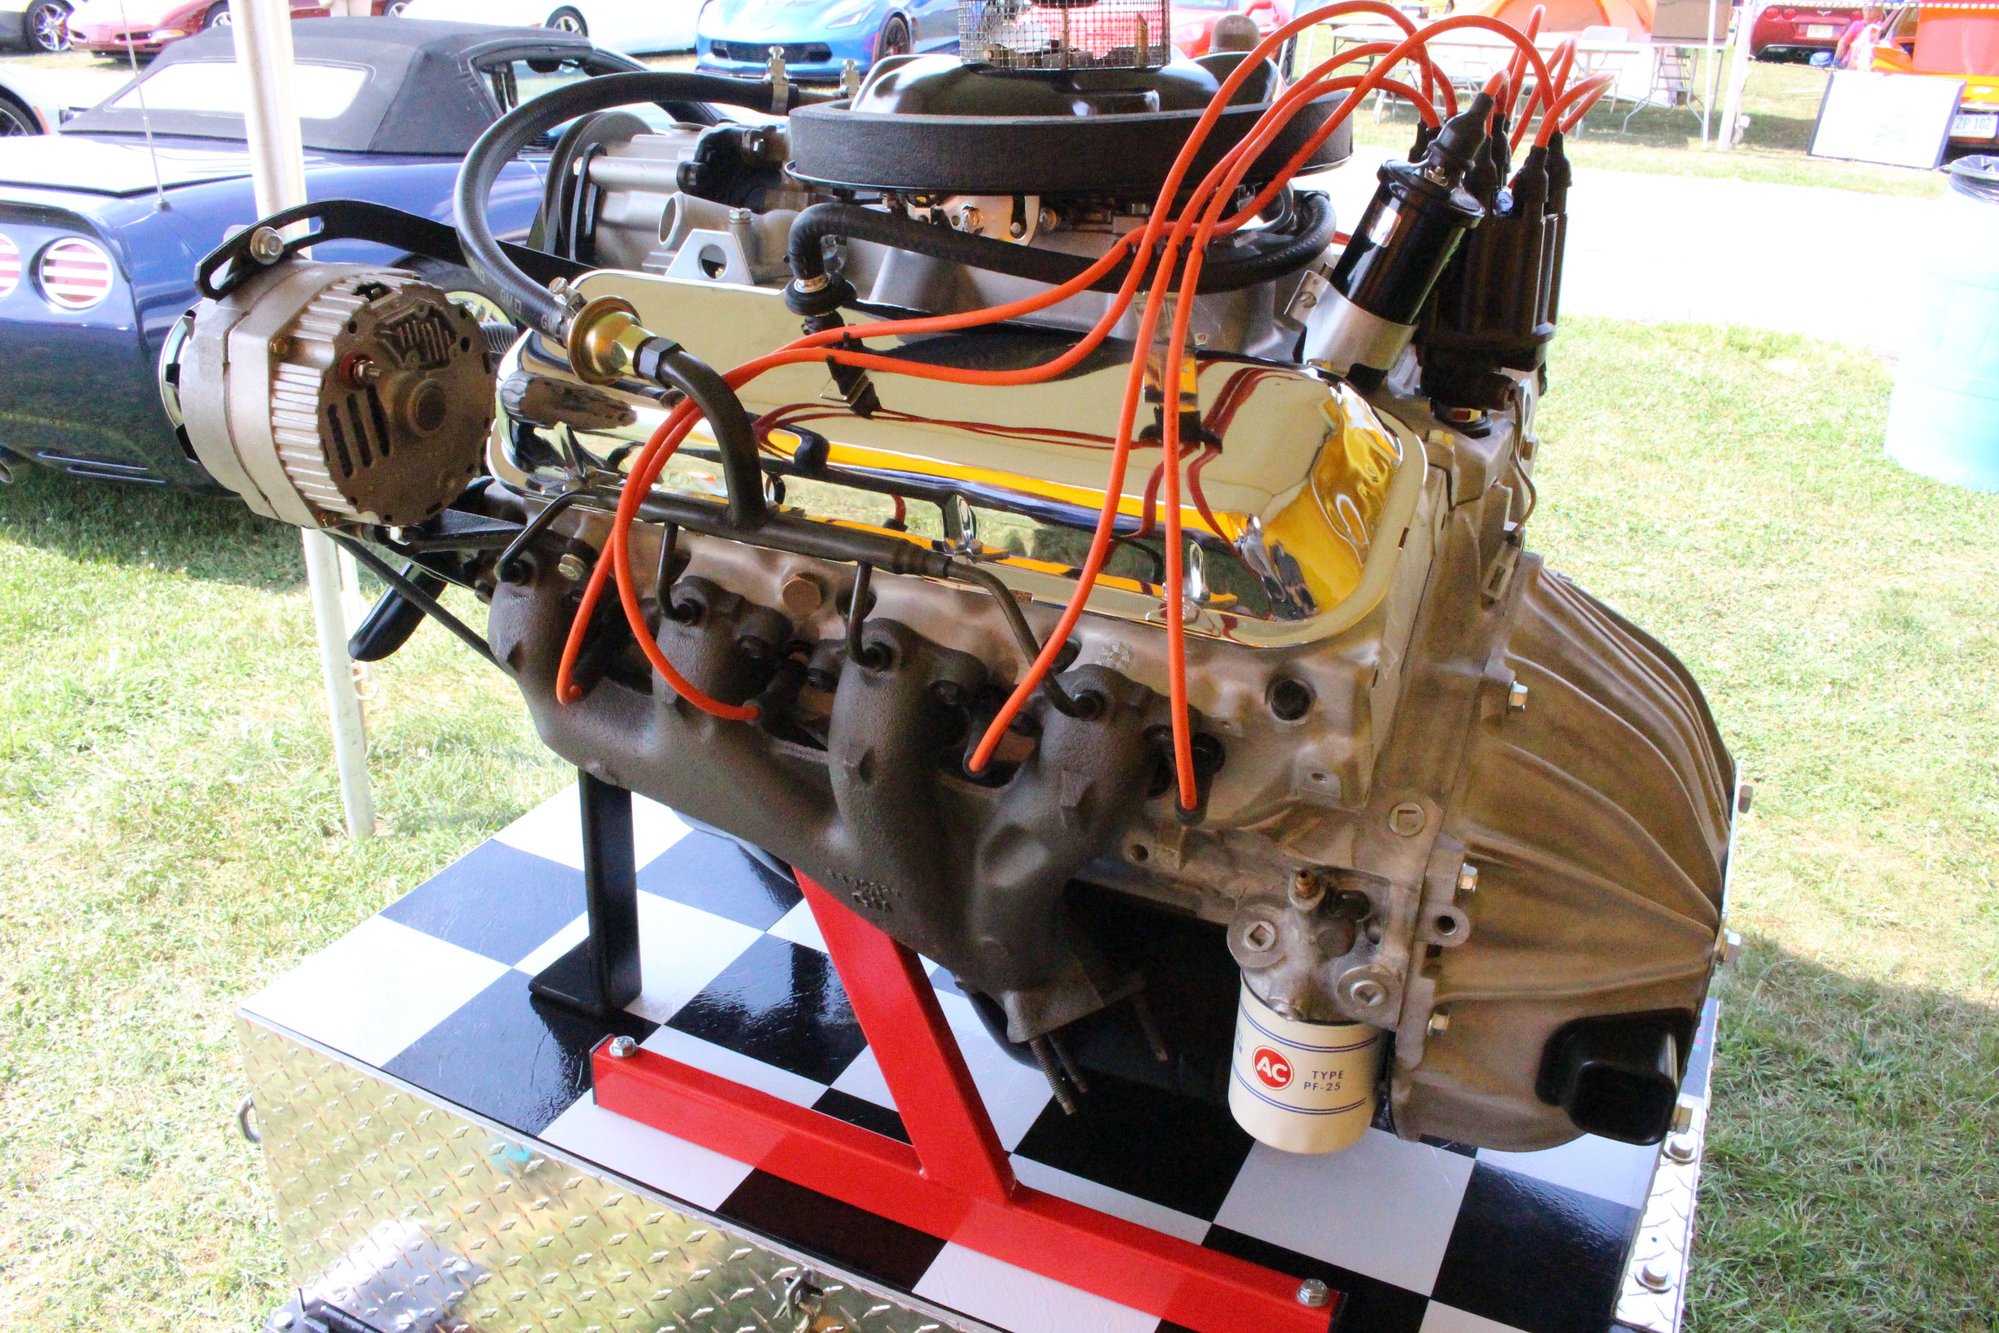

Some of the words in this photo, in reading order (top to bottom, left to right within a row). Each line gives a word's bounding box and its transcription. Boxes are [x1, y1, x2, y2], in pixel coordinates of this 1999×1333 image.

[1256, 1056, 1288, 1083] AC
[1312, 1070, 1345, 1080] TYPE
[1304, 1082, 1342, 1091] PF-25
